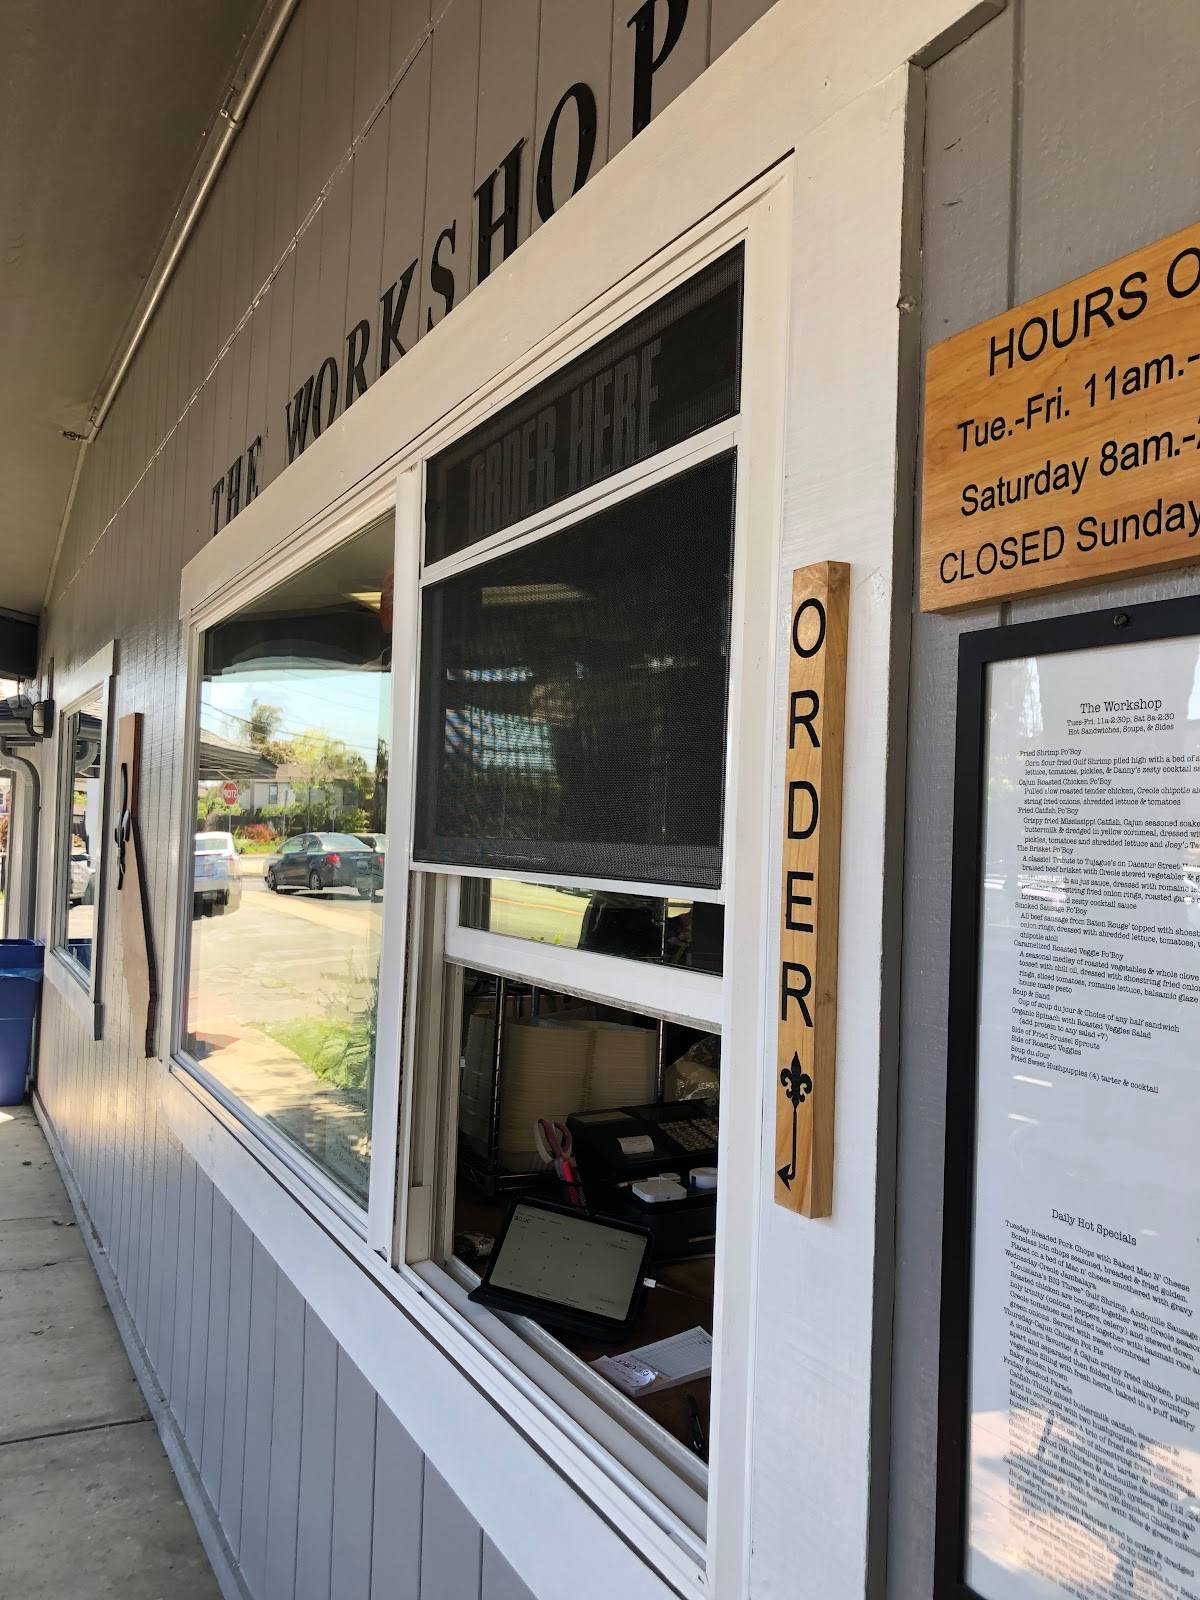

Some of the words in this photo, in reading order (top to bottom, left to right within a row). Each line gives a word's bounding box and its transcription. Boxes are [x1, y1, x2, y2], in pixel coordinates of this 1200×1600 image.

[211, 435, 262, 536] THE
[285, 0, 690, 466] WORKSHOP
[989, 271, 1148, 376] HOURS
[569, 336, 662, 488] HERE
[957, 386, 1070, 452] Tue.-Fri.
[961, 457, 1089, 517] Saturday
[1100, 416, 1200, 476] 8am.-
[940, 525, 1064, 584] CLOSED
[1076, 498, 1200, 552] Sunday
[1080, 703, 1101, 714] The
[1104, 699, 1162, 712] Workshop
[1155, 722, 1175, 731] Sides
[1113, 756, 1130, 766] piled
[1131, 756, 1147, 765] high
[1172, 755, 1186, 763] bed
[1113, 766, 1141, 774] Danny's
[1162, 765, 1192, 773] cocktail
[1063, 777, 1089, 786] Chicken
[1083, 797, 1114, 805] shredded
[1115, 798, 1139, 806] lettuce
[780, 598, 826, 1029] ORDER
[1100, 826, 1123, 837] yellow
[1160, 829, 1189, 838] dressed
[1091, 838, 1123, 847] shredded
[1124, 839, 1149, 848] lettuce
[1149, 840, 1164, 848] and
[1083, 868, 1098, 876] with
[1112, 880, 1140, 889] dressed
[1141, 883, 1157, 891] with
[1103, 887, 1123, 898] onion
[1145, 893, 1172, 902] roasted
[1090, 899, 1116, 908] cocktail
[1117, 902, 1137, 910] sauce
[1131, 924, 1156, 934] topped
[1157, 926, 1174, 935] with
[1098, 930, 1130, 940] shredded
[1131, 933, 1156, 943] lettuce,
[1159, 937, 1196, 948] tomatoes,
[1084, 960, 1109, 969] roasted
[1156, 969, 1178, 979] whole
[1162, 978, 1181, 989] fried
[1144, 988, 1177, 1000] balsamic
[1178, 994, 1199, 1004] glaze
[1105, 1023, 1131, 1035] Veggies
[1131, 1028, 1152, 1039] Salad
[1115, 1016, 1129, 1025] any
[1144, 1021, 1180, 1033] sandwich
[1101, 1075, 1122, 1085] tarter
[1130, 1082, 1159, 1094] cocktail
[1052, 1209, 1075, 1226] Daily
[1077, 1217, 1095, 1232] Hot
[1097, 1224, 1137, 1246] Specials
[1113, 1258, 1135, 1273] Baked
[1136, 1266, 1152, 1279] Mac
[1163, 1276, 1190, 1292] Cheese
[1152, 1295, 1169, 1308] with
[1170, 1302, 1193, 1317] gravy
[1129, 1330, 1144, 1341] and
[1172, 1347, 1194, 1362] down
[1175, 1393, 1200, 1410] pulled
[1169, 1415, 1196, 1432] pastry
